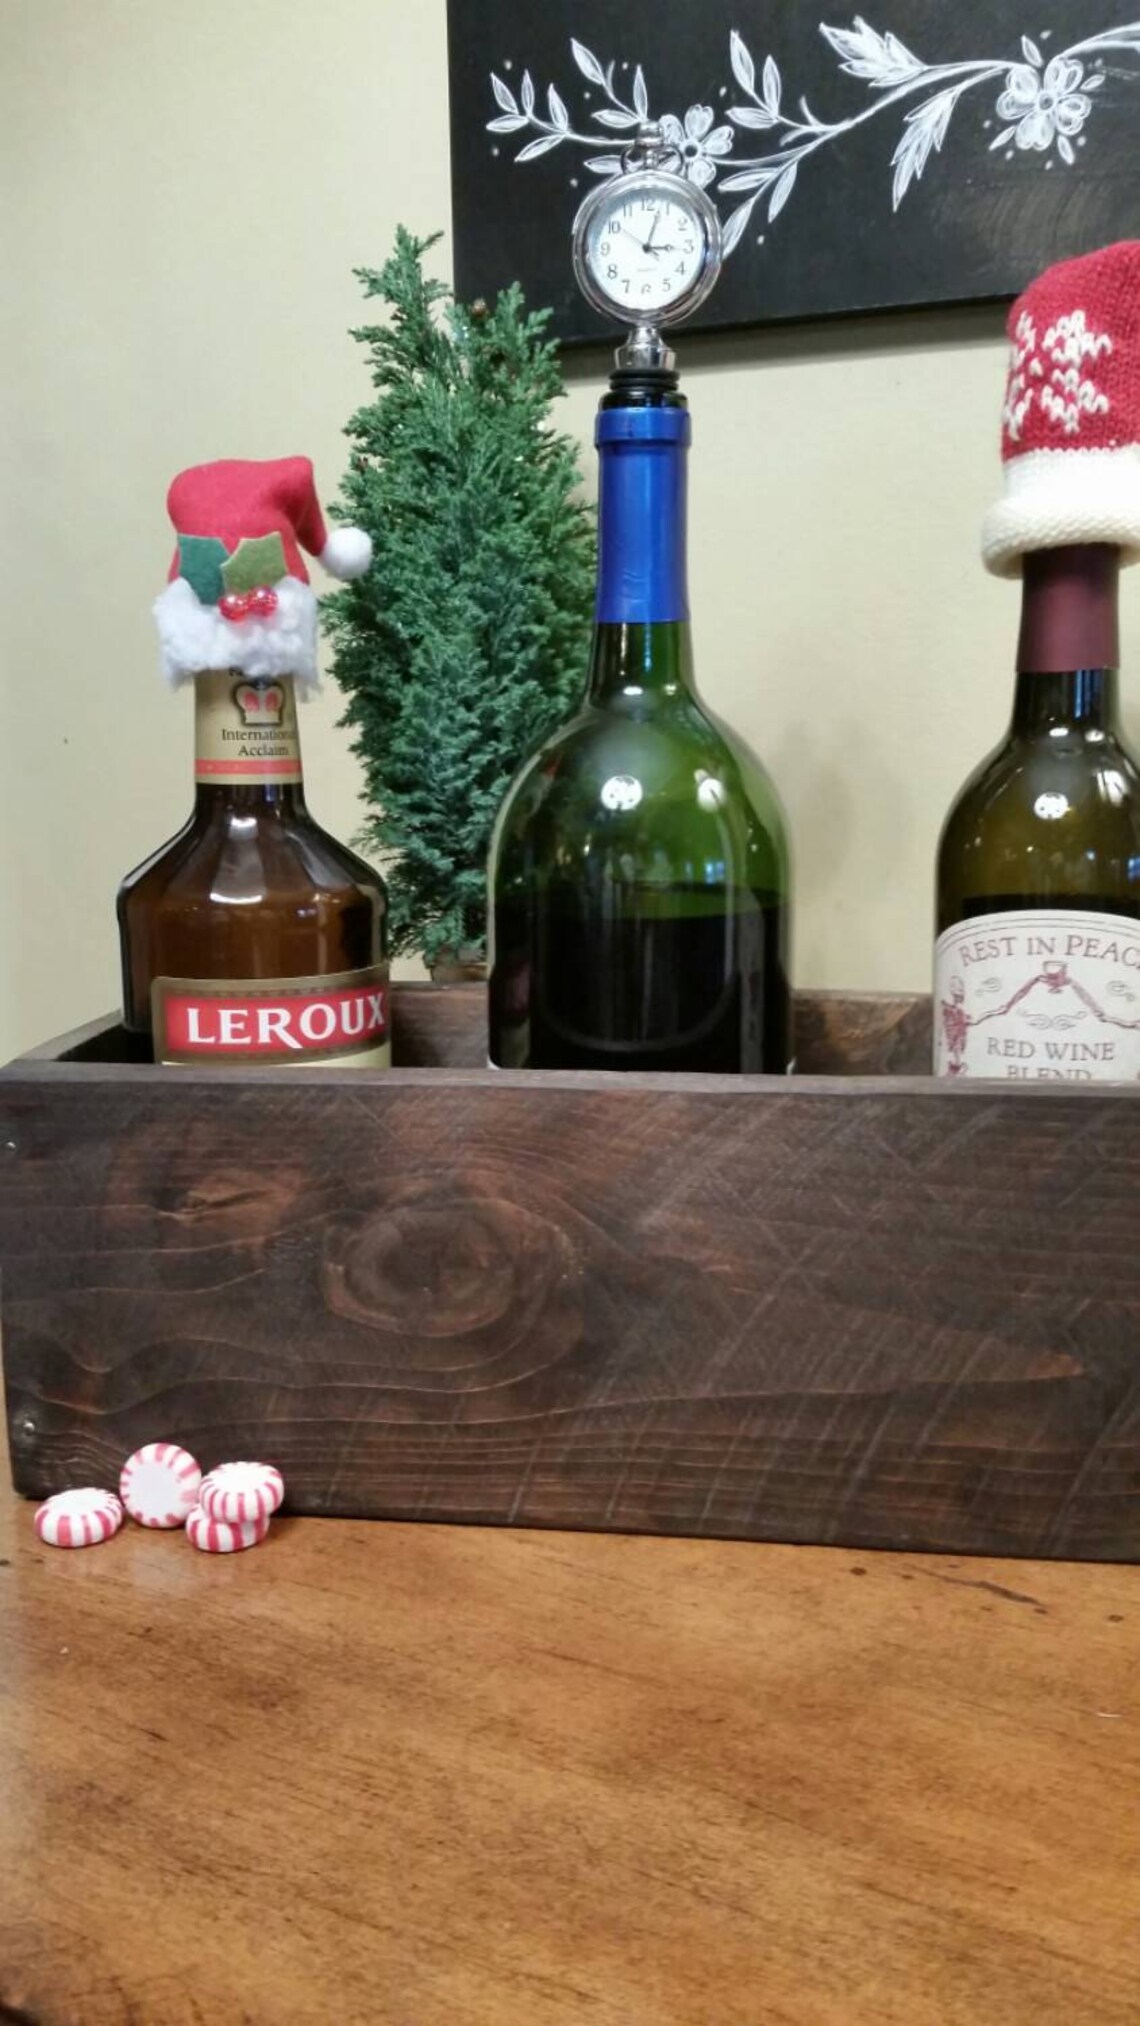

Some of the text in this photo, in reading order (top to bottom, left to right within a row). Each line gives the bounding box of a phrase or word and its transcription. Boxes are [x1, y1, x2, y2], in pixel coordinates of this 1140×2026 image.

[640, 199, 655, 212] 12
[608, 221, 621, 235] 10
[600, 242, 611, 256] 9
[683, 239, 694, 254] 3
[607, 264, 618, 280] 8
[674, 262, 685, 276] 4
[621, 279, 631, 294] 7
[662, 278, 671, 292] 5
[238, 745, 289, 757] Acclaim
[959, 934, 1140, 971] REST IN PEAC
[187, 991, 385, 1049] LEROUX
[986, 1037, 1116, 1061] RED WINE
